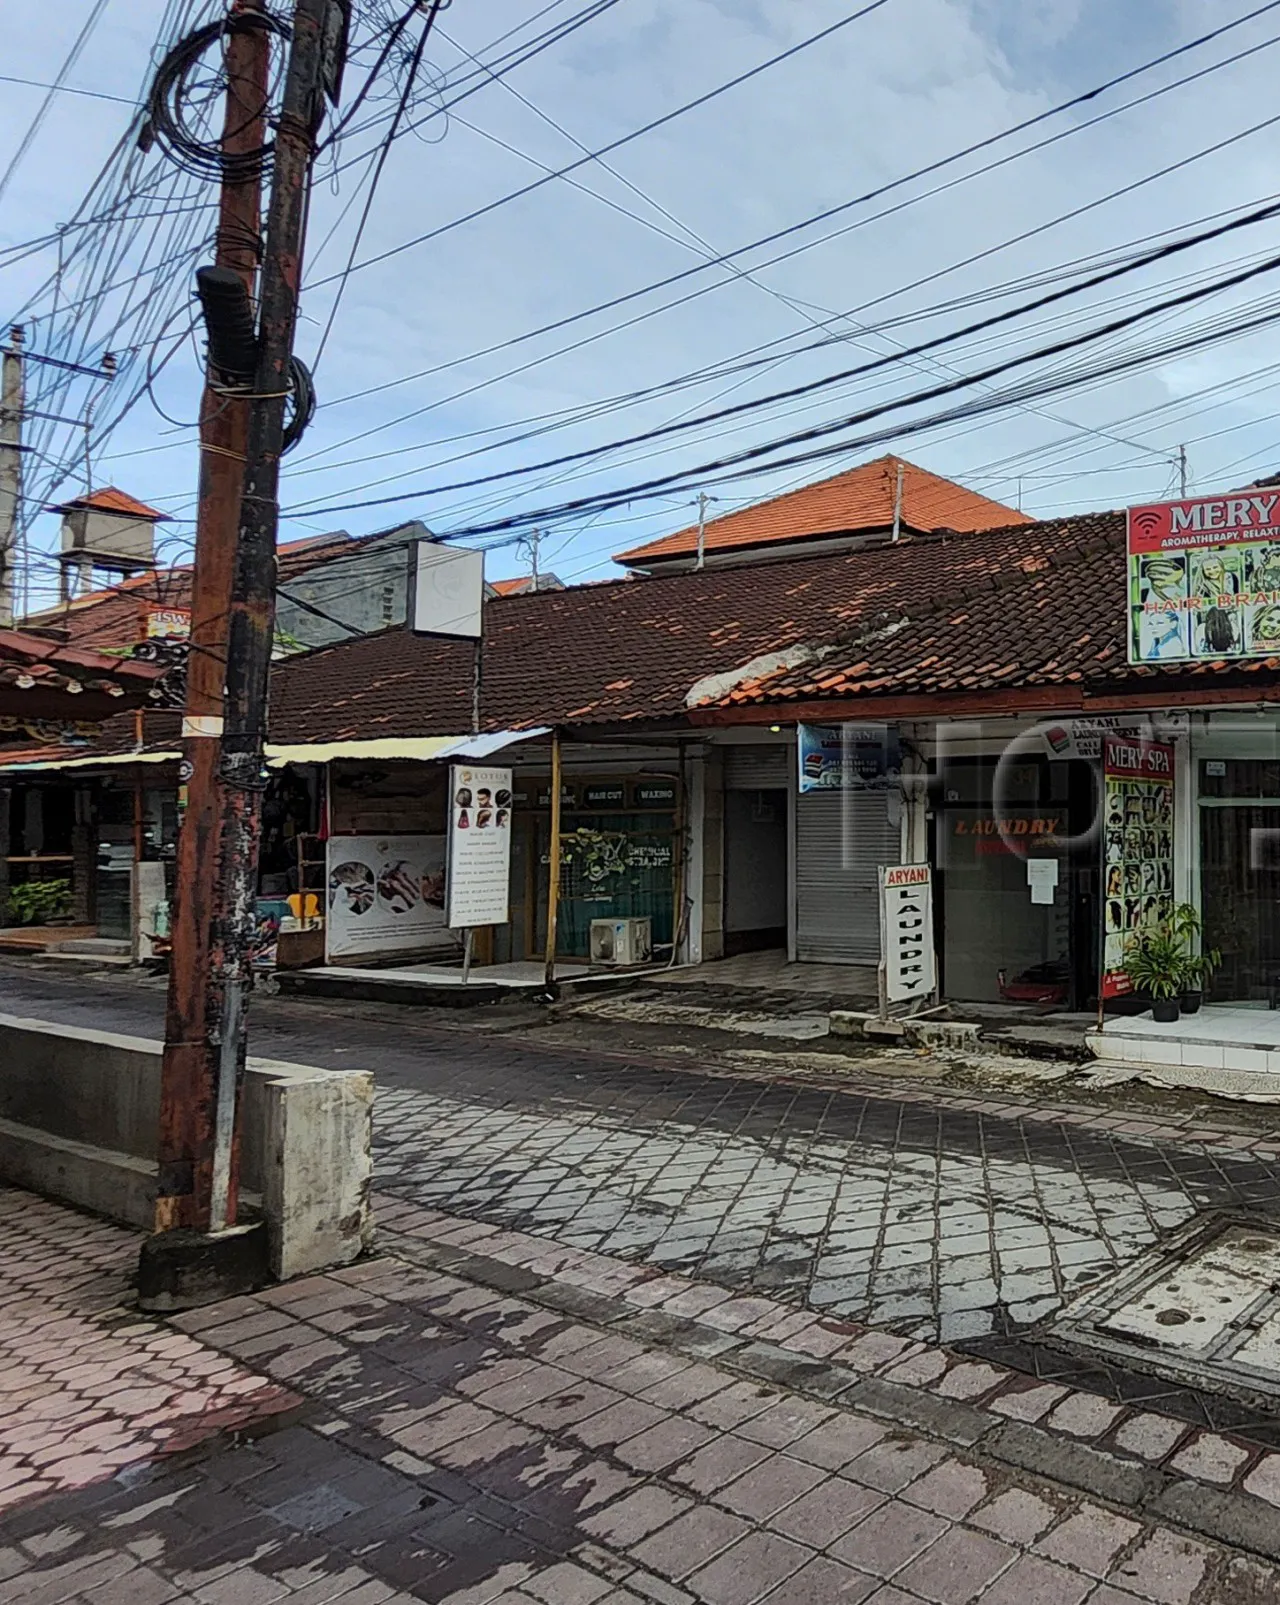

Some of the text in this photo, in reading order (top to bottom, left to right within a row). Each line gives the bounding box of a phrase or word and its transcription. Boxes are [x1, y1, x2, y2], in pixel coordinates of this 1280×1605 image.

[1169, 493, 1279, 533] MERY
[1160, 530, 1240, 547] AROMATHERAPY,
[1143, 596, 1202, 615] HAIR
[1108, 744, 1170, 773] MERY SPA
[955, 817, 1060, 836] LAUNDRY
[887, 868, 928, 885] ARYANI
[896, 890, 924, 990] LAUNDRY
